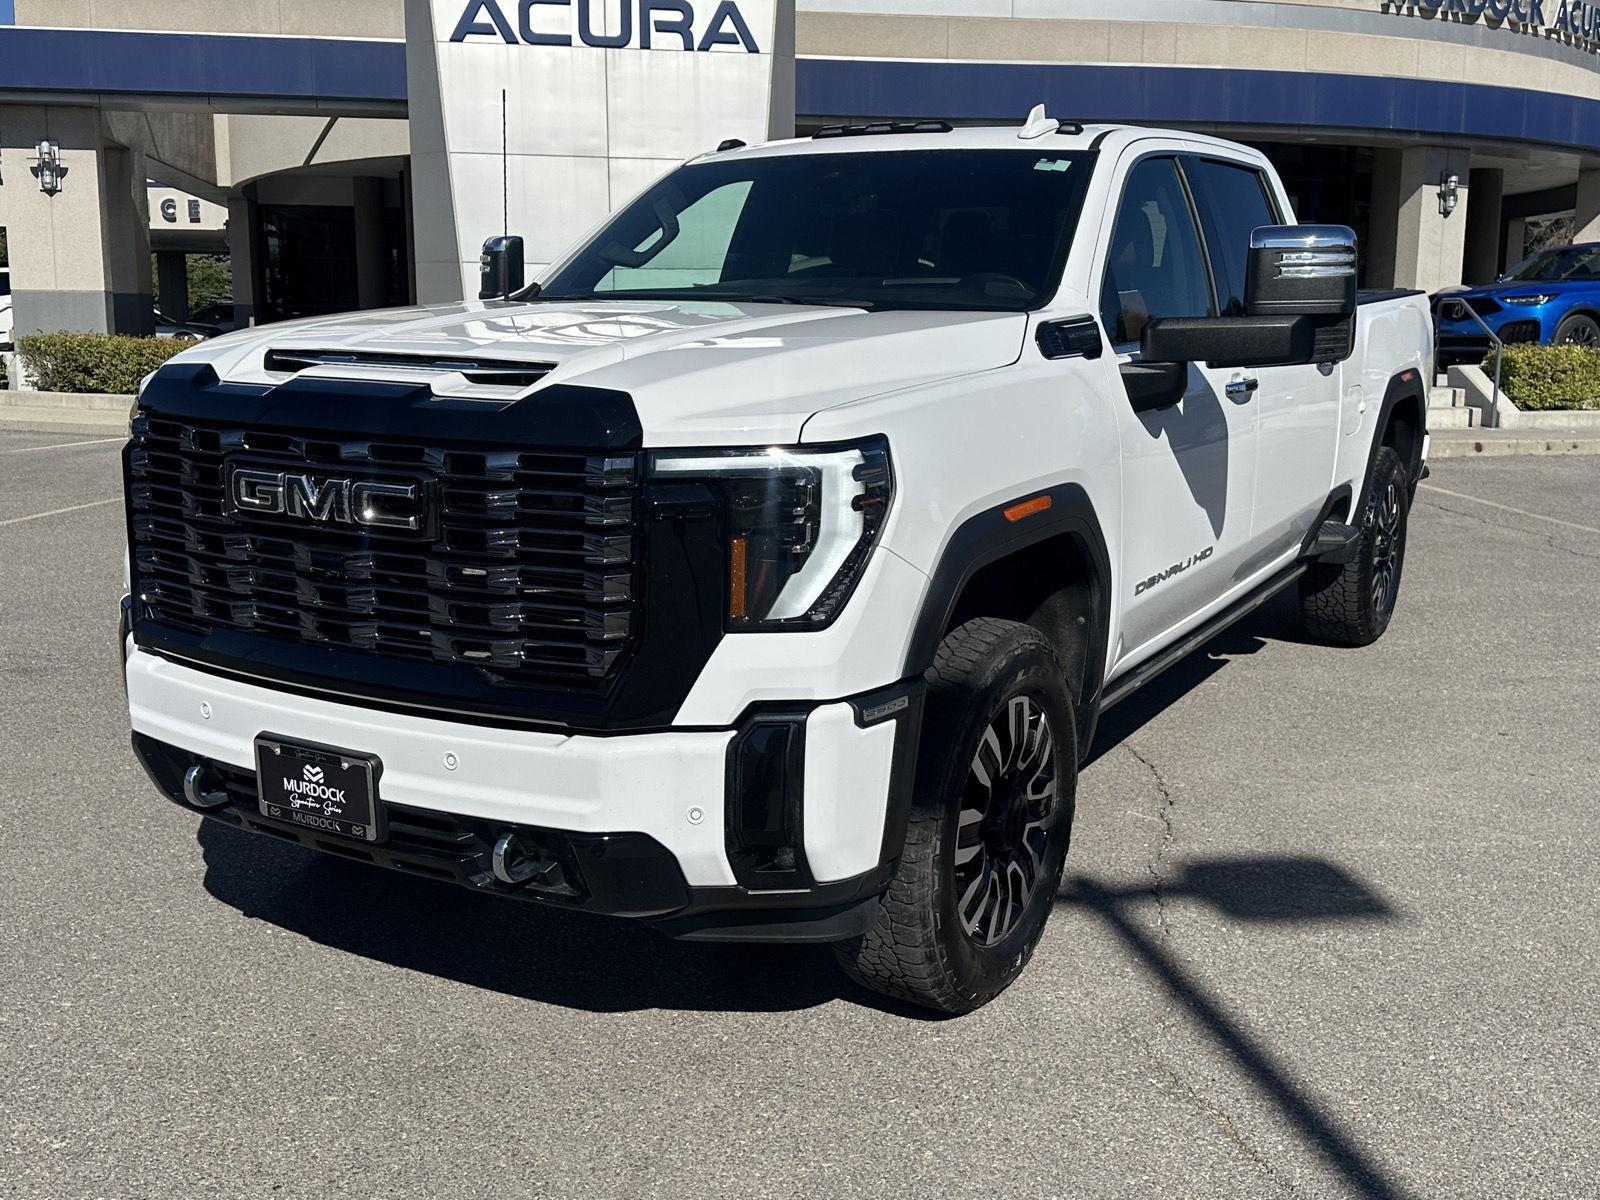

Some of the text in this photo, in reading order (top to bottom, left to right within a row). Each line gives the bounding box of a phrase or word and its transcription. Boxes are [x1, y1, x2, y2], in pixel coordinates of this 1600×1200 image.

[449, 0, 760, 53] ACURA
[1387, 0, 1545, 26] DOCK
[232, 469, 418, 530] GMC
[1134, 546, 1213, 597] DENALI HD
[283, 777, 346, 804] MURDOCK
[290, 793, 342, 815] Signature Series
[293, 811, 341, 831] MURDOCK
